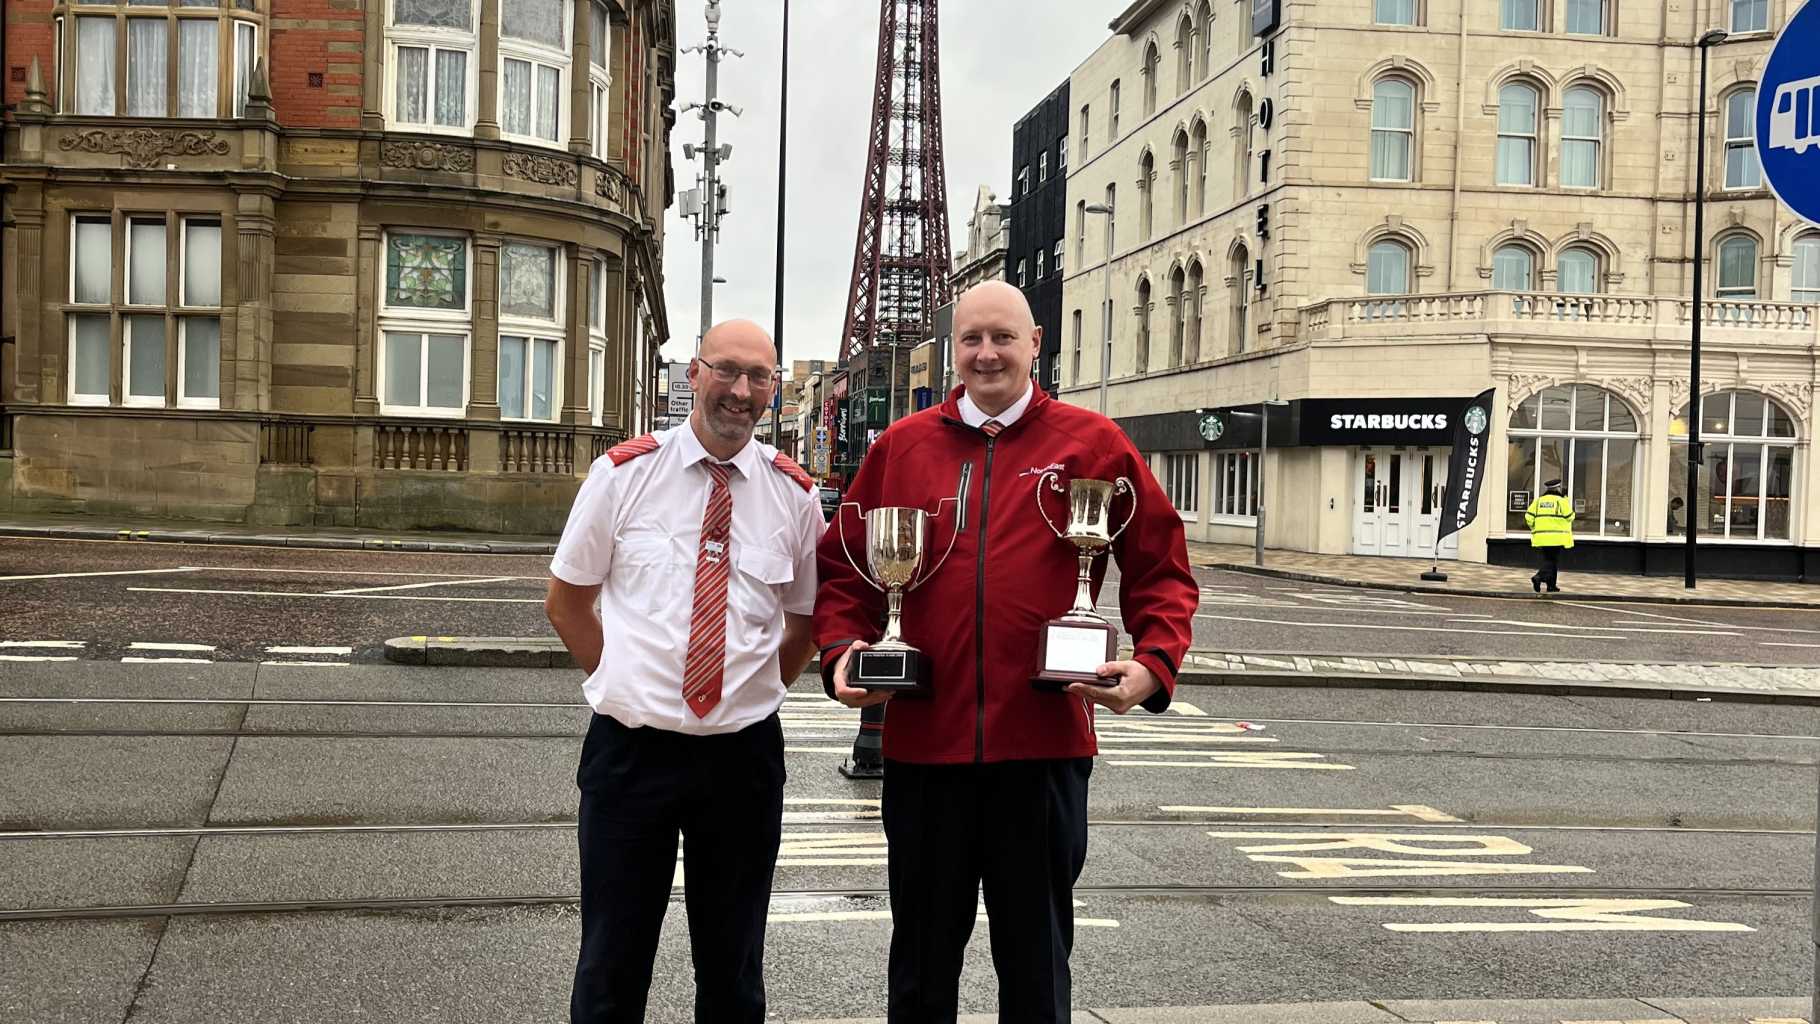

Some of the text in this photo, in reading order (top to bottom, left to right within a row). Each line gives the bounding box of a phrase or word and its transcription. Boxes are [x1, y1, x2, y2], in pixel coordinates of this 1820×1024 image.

[1254, 40, 1275, 291] HOTEL
[1330, 414, 1447, 429] STARBUCKS
[1456, 437, 1479, 528] STARBUCKS
[1157, 804, 1757, 931] TRAM
